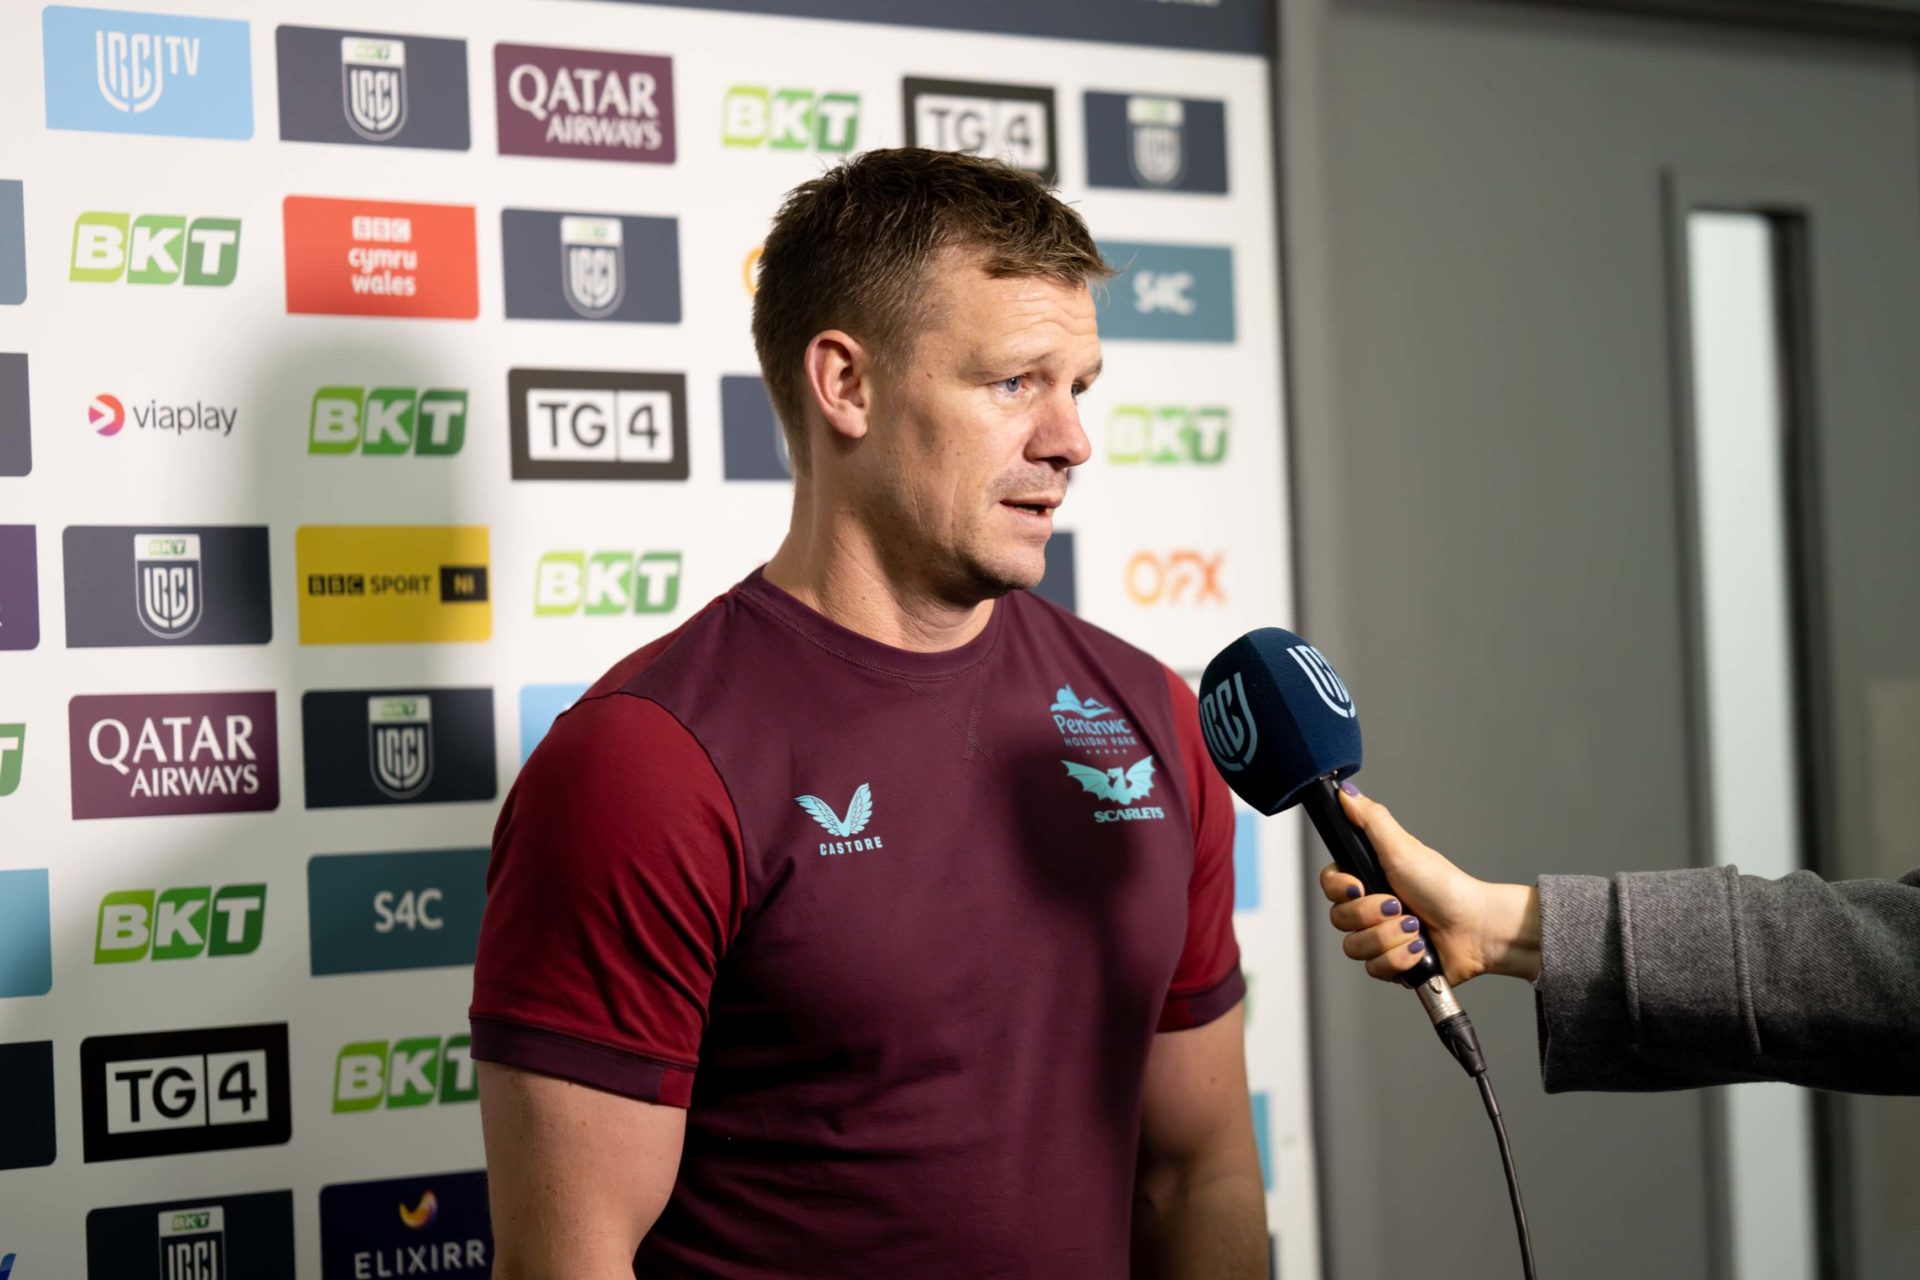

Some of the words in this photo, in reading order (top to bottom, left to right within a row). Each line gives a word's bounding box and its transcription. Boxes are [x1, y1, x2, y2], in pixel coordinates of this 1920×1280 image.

[165, 35, 201, 76] TV
[508, 63, 659, 119] QATAR
[546, 114, 662, 150] AIRWAYS
[724, 88, 859, 149] BKT
[70, 213, 240, 285] BKT
[348, 246, 417, 275] cymru
[351, 269, 416, 297] wales
[133, 400, 238, 437] viaplay
[309, 387, 467, 455] BKT
[308, 574, 364, 596] BBC
[370, 575, 431, 594] SPORT
[453, 574, 476, 595] NI
[536, 554, 681, 615] BKT
[89, 715, 257, 775] QATAR
[1064, 736, 1108, 748] HOLIDAY
[1110, 735, 1137, 747] PARK
[131, 764, 259, 798] AIRWAYS
[1094, 806, 1165, 823] SCARLETS
[819, 836, 883, 856] CASTORE
[95, 885, 266, 963] BKT
[374, 888, 444, 933] S4C
[333, 1037, 478, 1113] BKT
[172, 1212, 211, 1231] BKT
[354, 1239, 487, 1280] ELIXIRR
